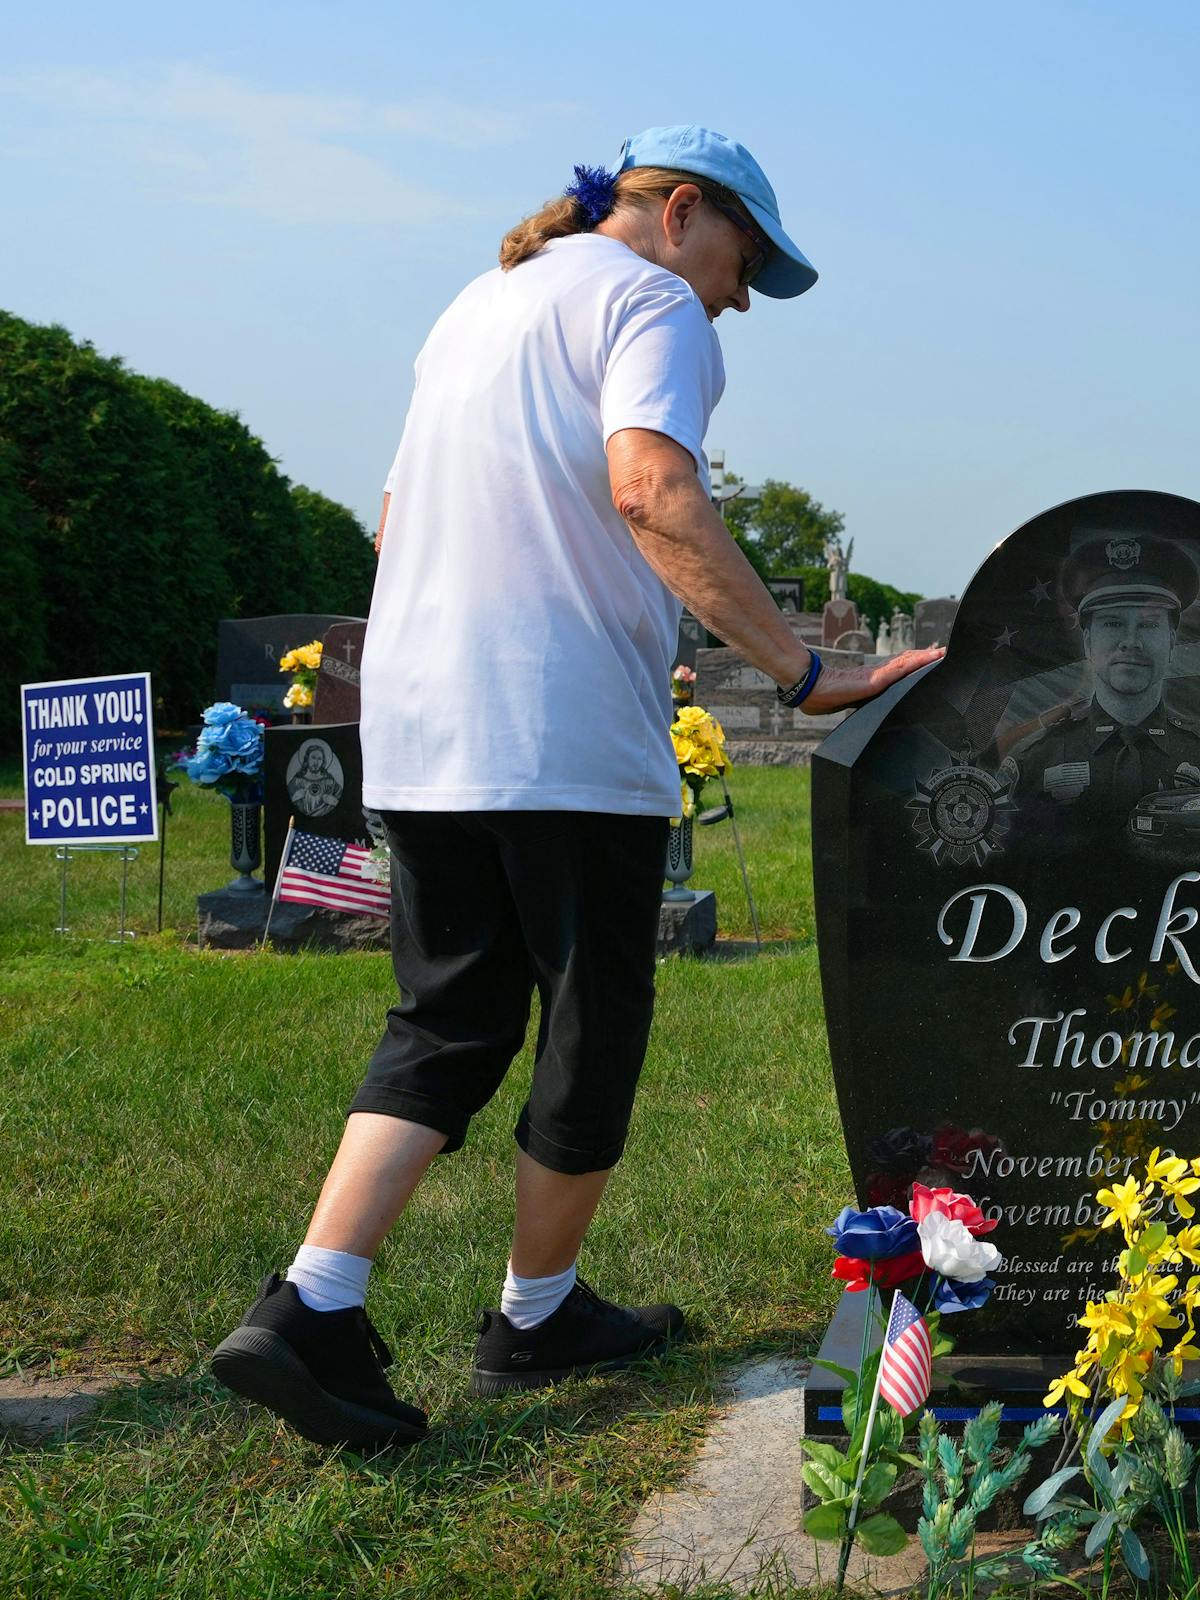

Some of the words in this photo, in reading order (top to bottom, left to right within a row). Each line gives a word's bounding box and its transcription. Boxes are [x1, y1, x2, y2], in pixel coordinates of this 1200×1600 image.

[27, 695, 89, 730] THANK
[94, 689, 143, 725] YOU!
[31, 739, 52, 762] for
[54, 741, 87, 760] your
[91, 732, 142, 752] service
[34, 766, 76, 788] COLD
[80, 761, 146, 785] SPRING
[41, 795, 137, 828] POLICE
[961, 1145, 1139, 1179] November
[979, 1192, 1110, 1226] ovembe
[996, 1255, 1063, 1273] Blessed
[1067, 1261, 1094, 1273] are
[1102, 1256, 1120, 1273] th
[994, 1283, 1036, 1306] They
[1043, 1289, 1070, 1301] are
[1078, 1283, 1106, 1301] the
